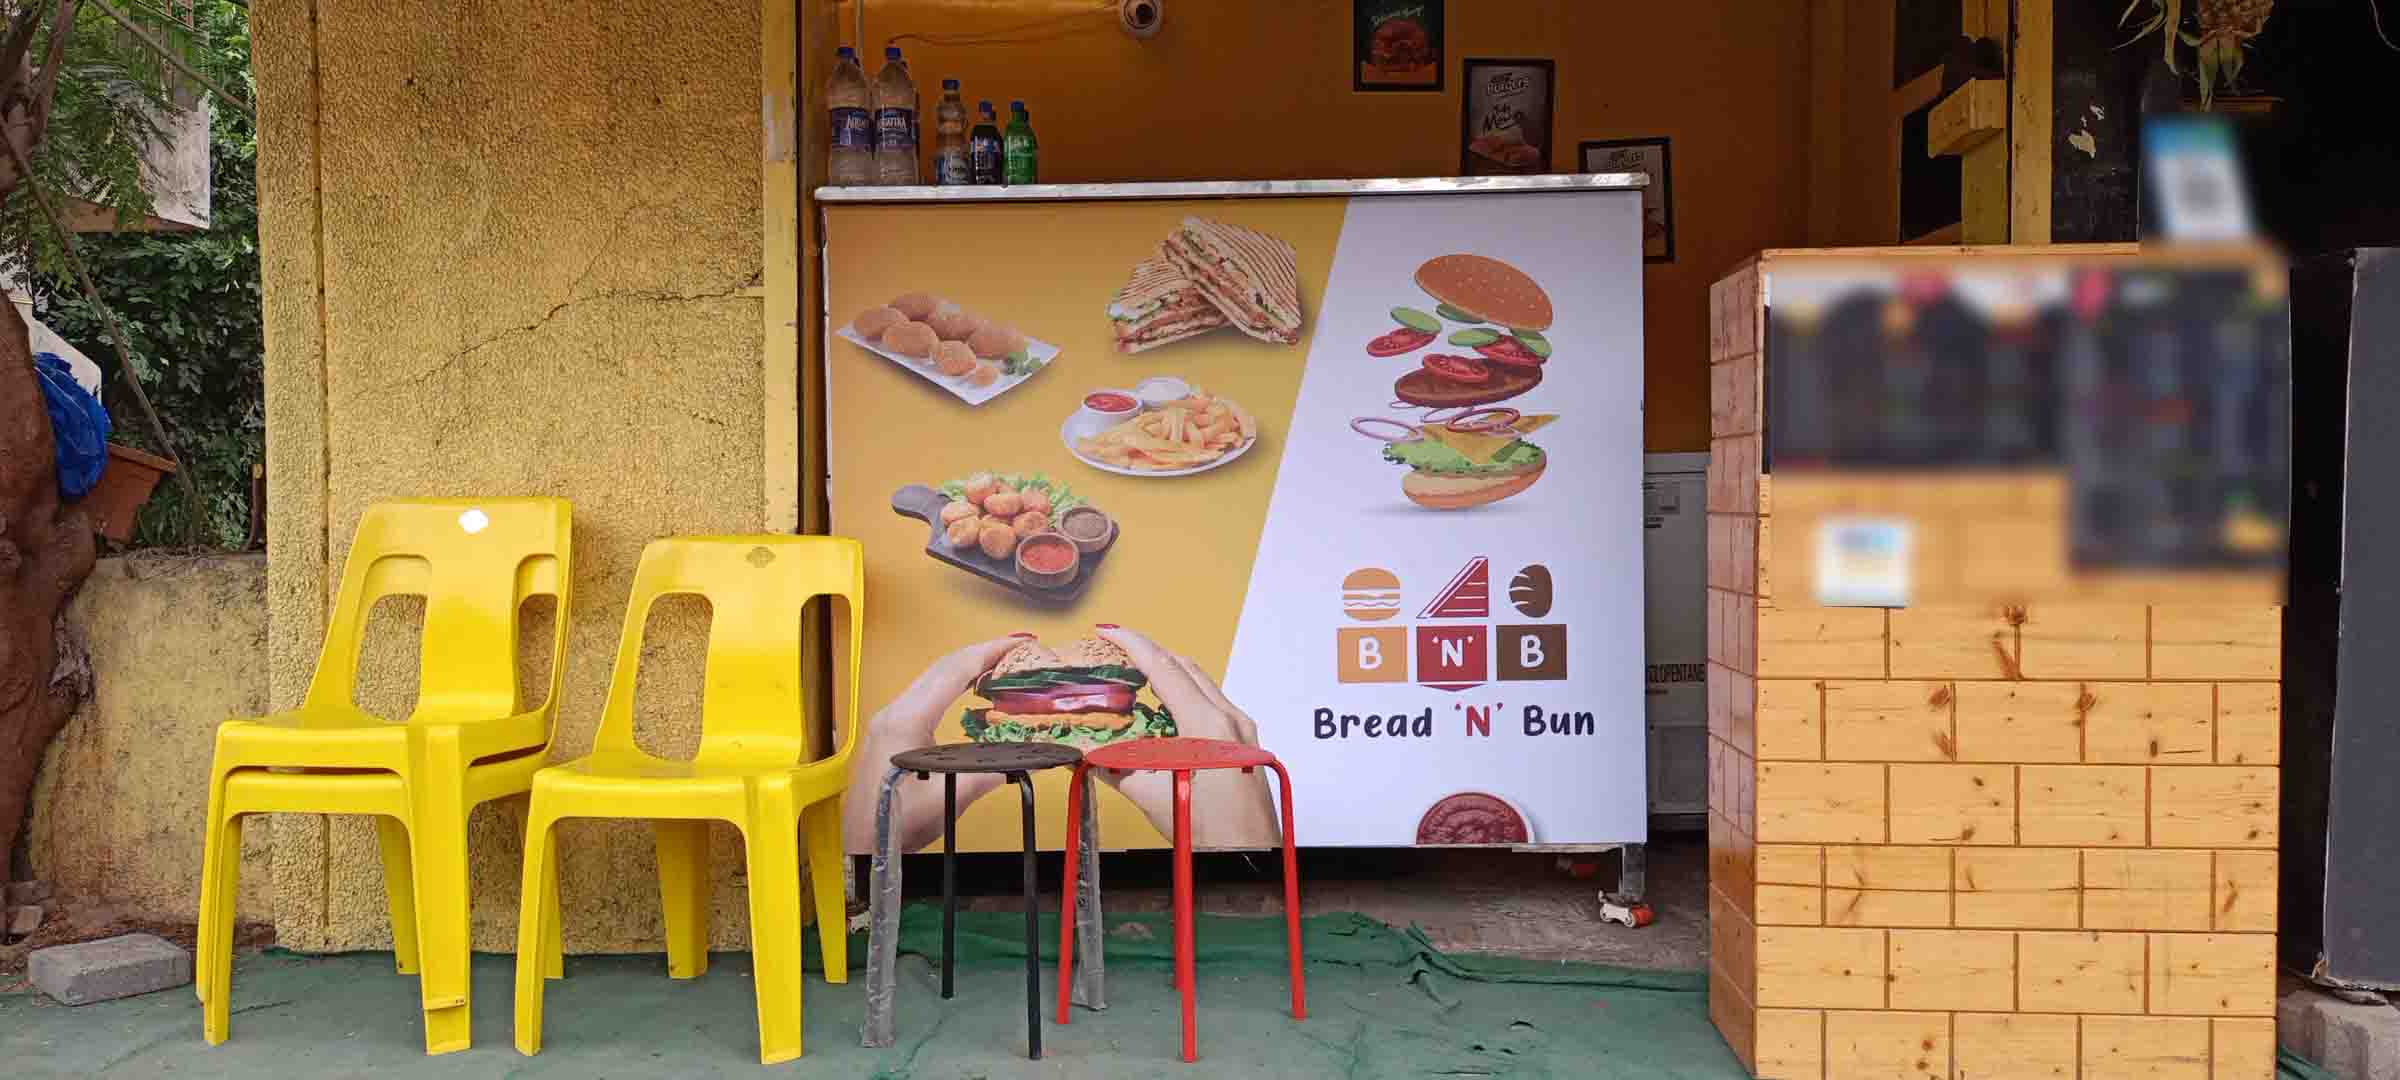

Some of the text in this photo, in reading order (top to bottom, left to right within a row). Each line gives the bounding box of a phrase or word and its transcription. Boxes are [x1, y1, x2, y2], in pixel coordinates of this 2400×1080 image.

[1358, 634, 1545, 670] B 'N' B
[1647, 663, 1706, 684] CLOPENTANE
[1313, 702, 1595, 740] Bread 'N' Bun
